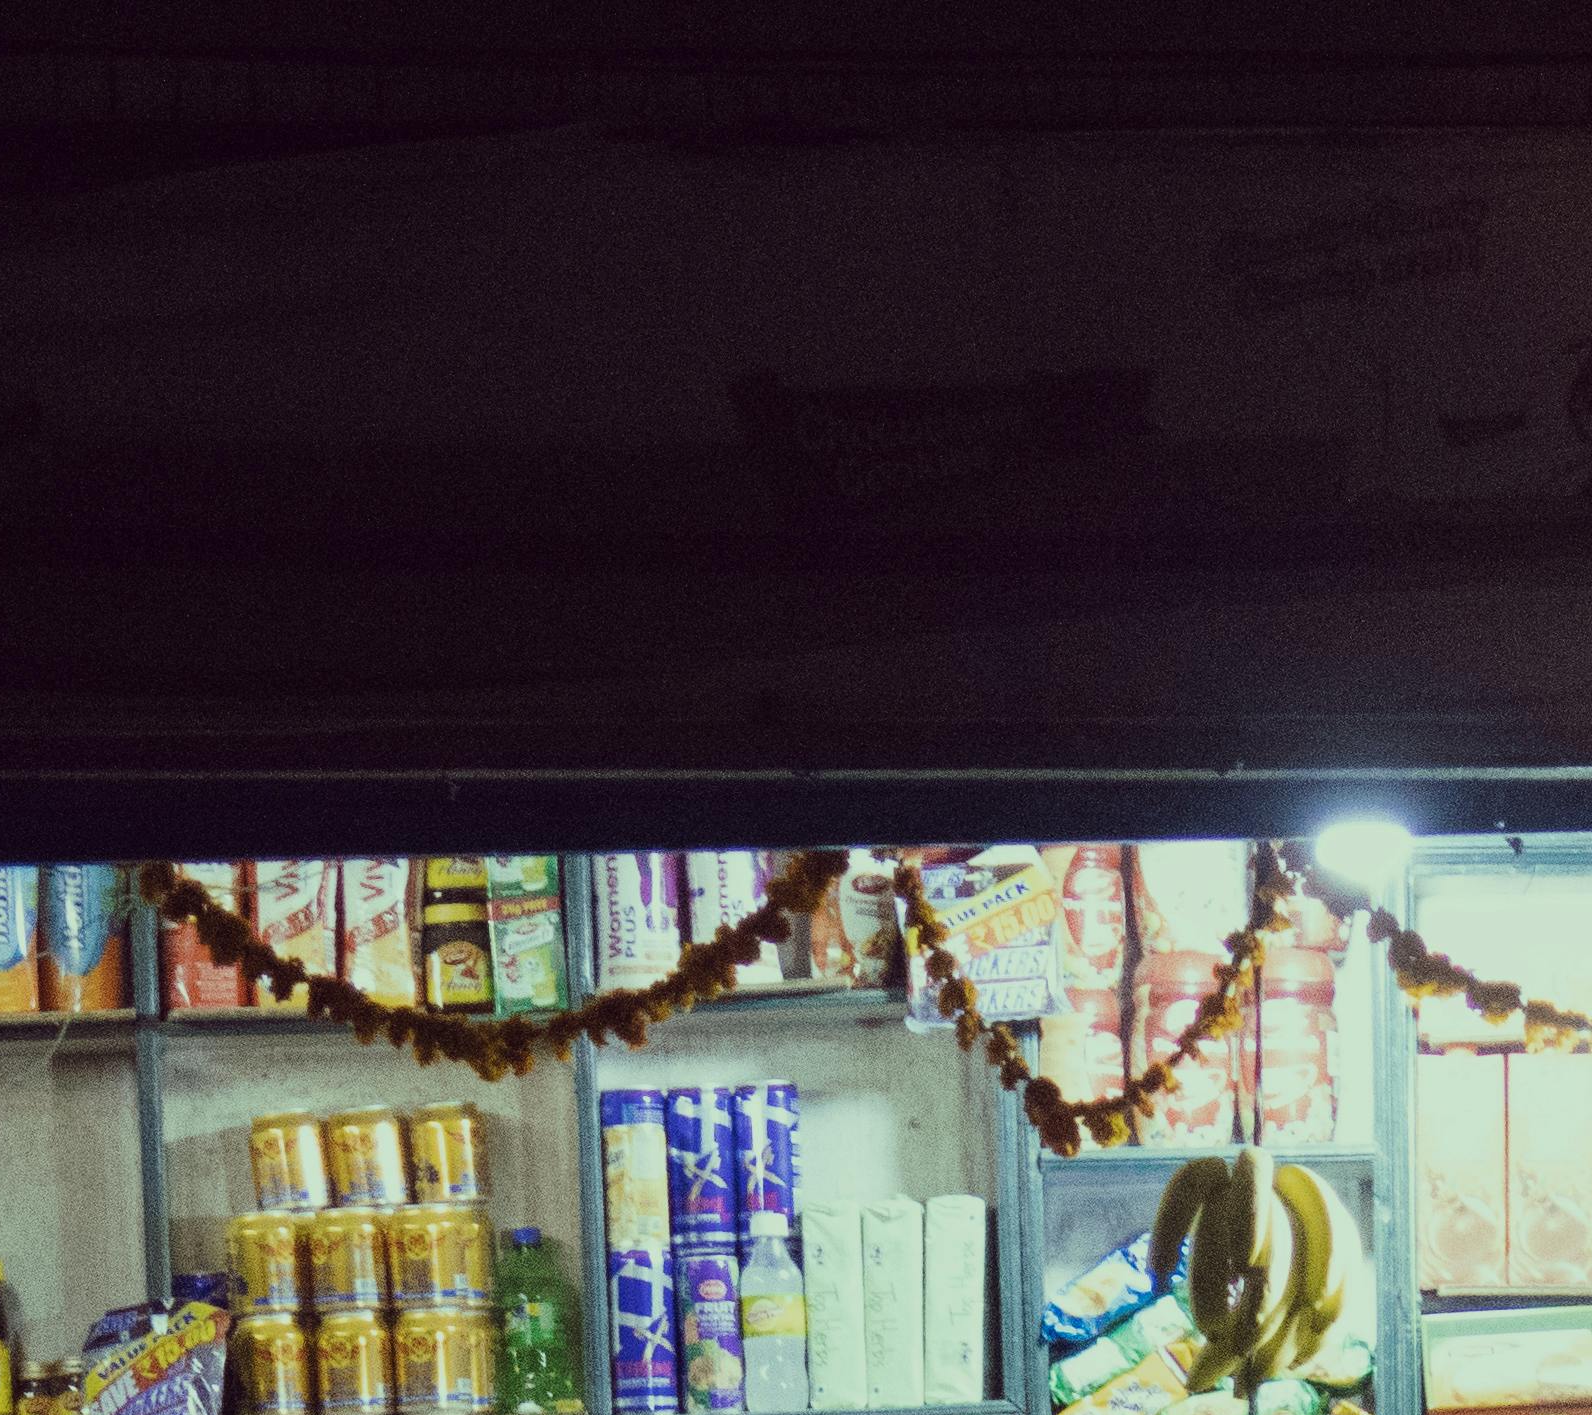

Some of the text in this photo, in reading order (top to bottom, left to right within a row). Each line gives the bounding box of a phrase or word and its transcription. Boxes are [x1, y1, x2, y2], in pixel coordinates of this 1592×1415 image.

[59, 866, 84, 948] Horlic
[983, 883, 1031, 910] PACK
[624, 905, 637, 959] PLUS
